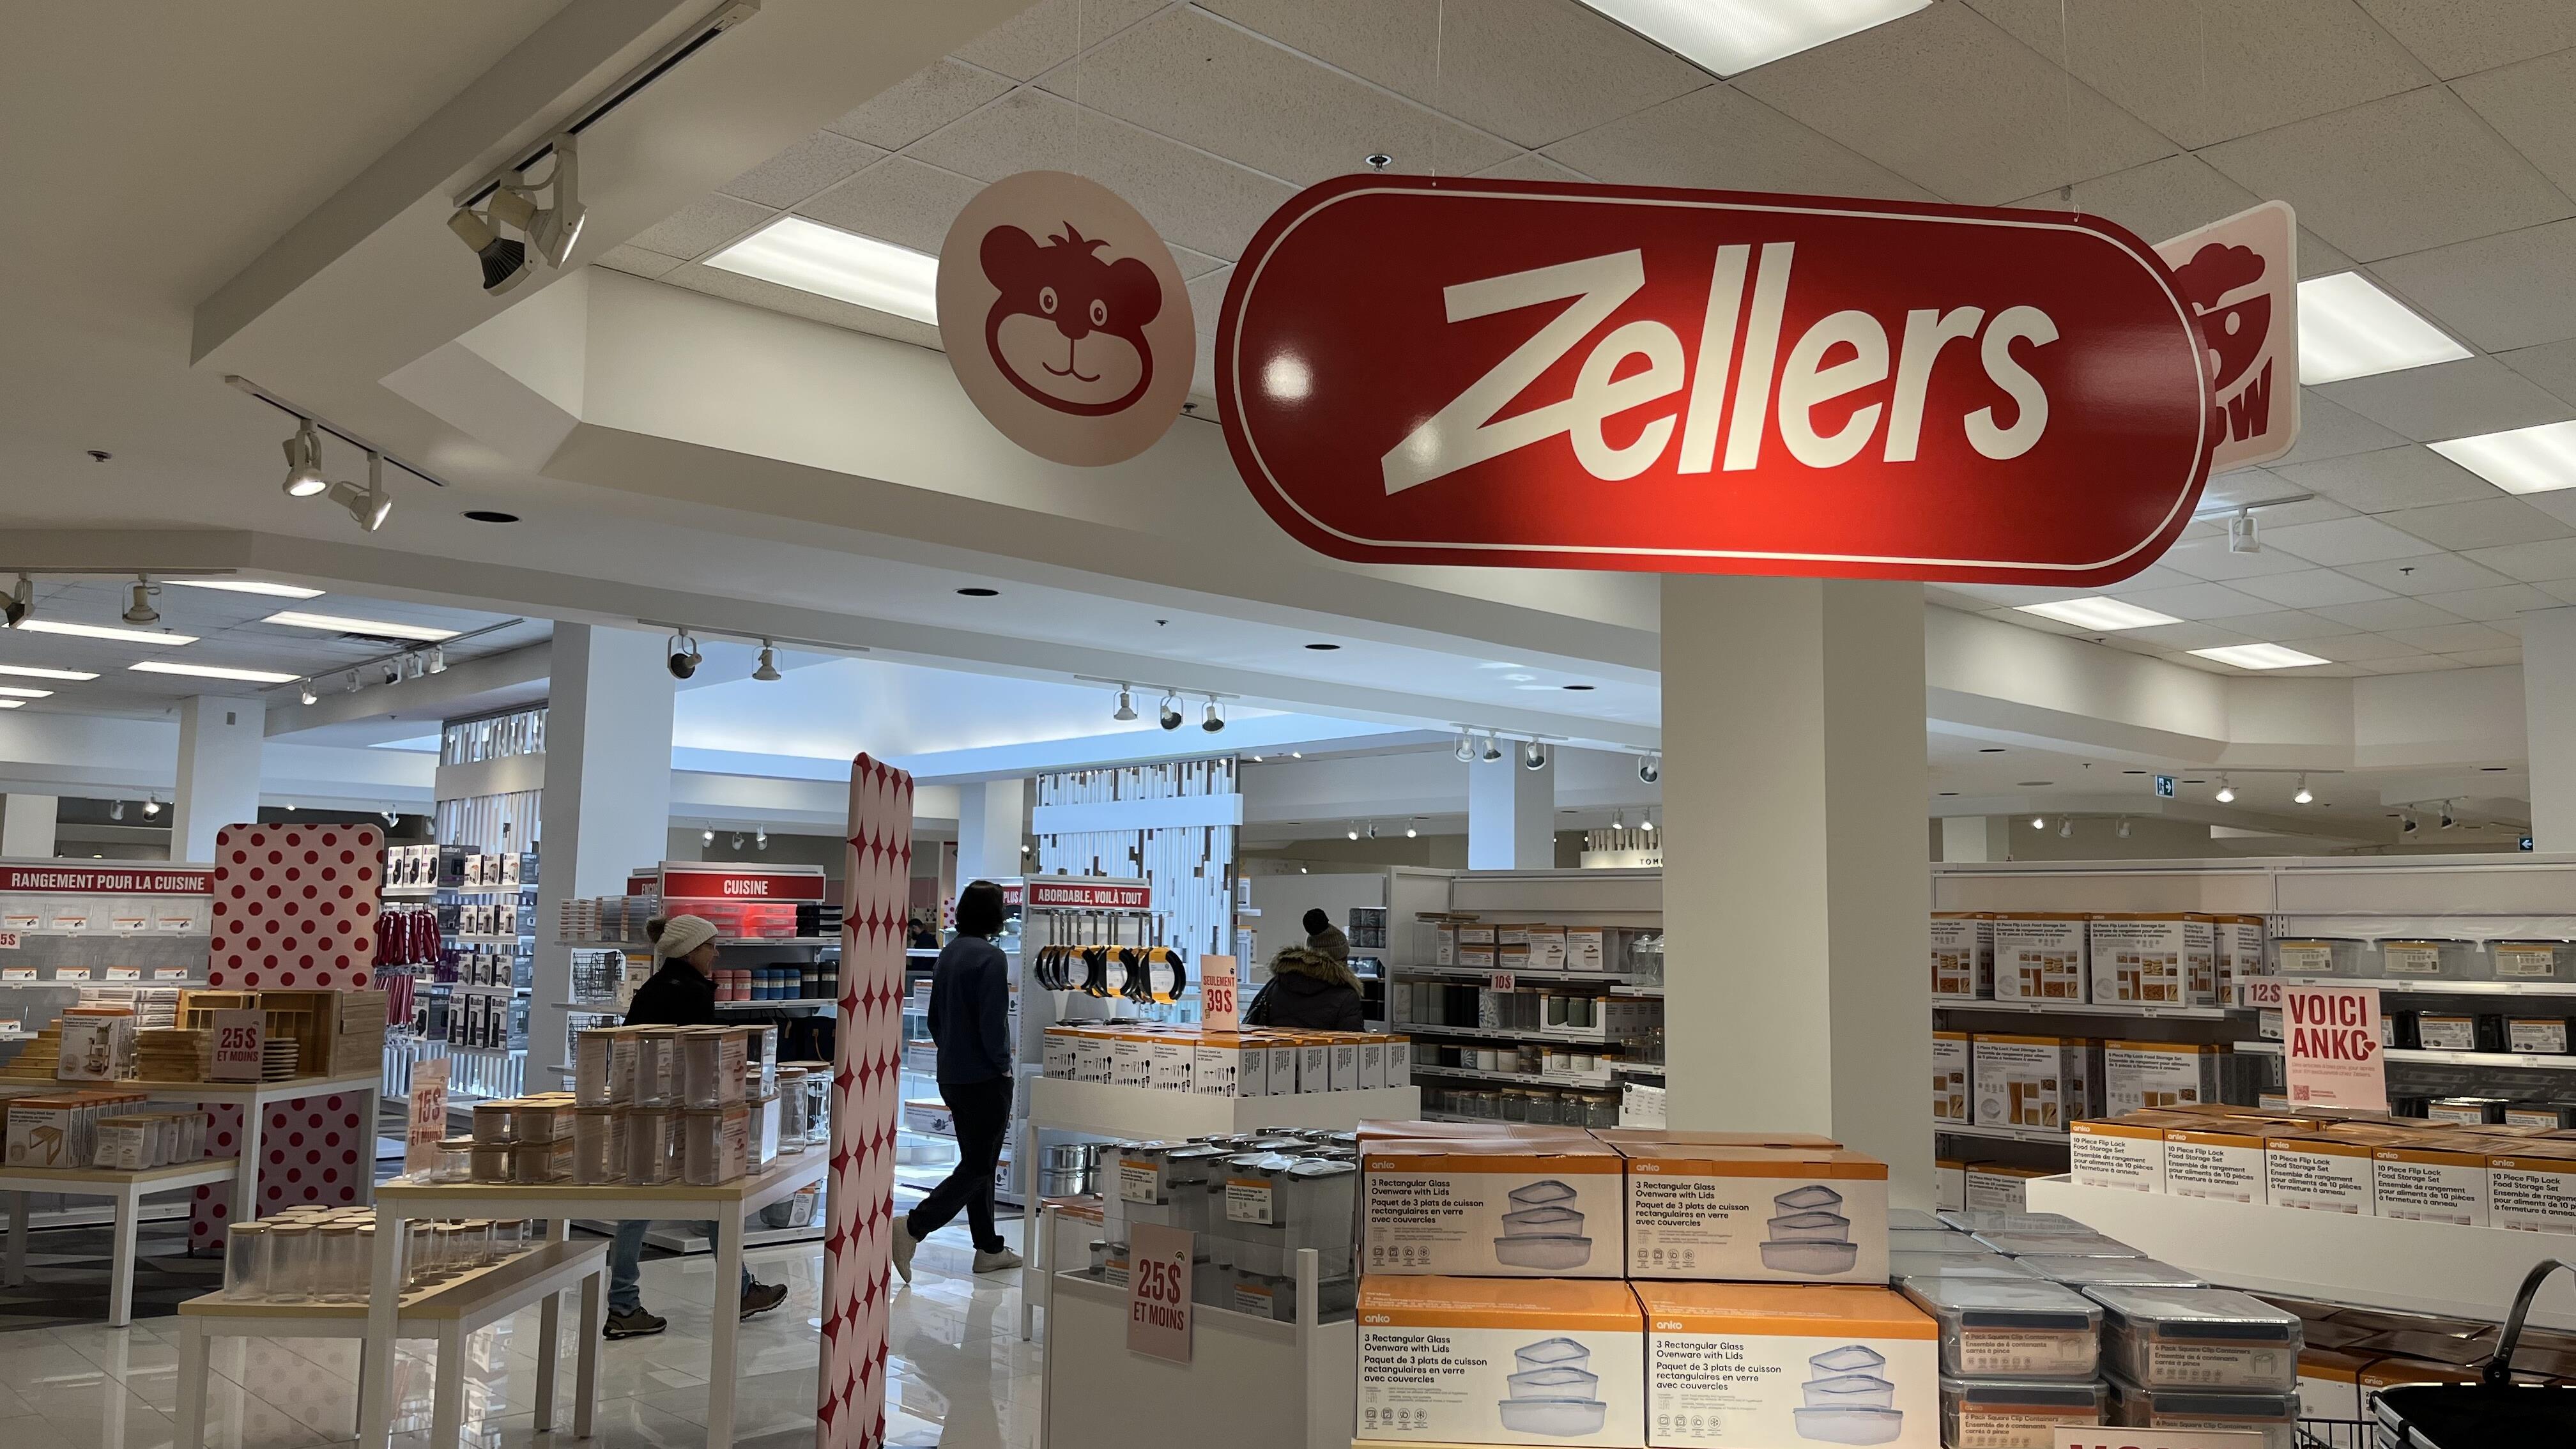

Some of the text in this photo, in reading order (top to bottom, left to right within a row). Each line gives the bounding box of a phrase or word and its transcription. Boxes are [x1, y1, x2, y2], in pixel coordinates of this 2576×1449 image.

[1381, 241, 2060, 496] Zellers
[12, 873, 204, 891] RANGEMENT POUR LA CUISINE
[724, 880, 769, 894] CUISINE
[1003, 891, 1018, 903] PLUS
[1038, 889, 1142, 905] ABORDABLE, VOILÀ TOUT
[1204, 976, 1234, 987] SEULEMENT
[1496, 975, 1511, 989] 10$
[2251, 983, 2280, 1003] 12$
[1207, 988, 1232, 1015] 39$
[2288, 994, 2367, 1027] VOICI
[221, 1027, 256, 1050] 25$
[2292, 1028, 2370, 1061] ANKO
[217, 1051, 259, 1062] ET MOINS
[418, 1086, 441, 1123] 15$
[411, 1130, 419, 1146] ET
[2099, 1139, 2109, 1147] Flip
[2089, 1145, 2112, 1153] Storage
[1372, 1161, 1395, 1169] anko
[1636, 1163, 1660, 1172] anko
[2288, 1163, 2315, 1171] Storage
[2271, 1170, 2303, 1178] Ensemble
[1379, 1179, 1427, 1188] Rectangular
[2277, 1184, 2311, 1193] fermeture
[2288, 1177, 2317, 1186] aliments
[2338, 1182, 2362, 1190] pièces
[1372, 1199, 1399, 1208] Paquet
[1421, 1199, 1439, 1208] plats
[1372, 1208, 1429, 1216] rectangulaires
[1137, 1258, 1182, 1307] 25$
[1133, 1301, 1184, 1331] ET MOINS
[1365, 1314, 1390, 1323] anko
[1657, 1319, 1682, 1330] anko
[1372, 1334, 1425, 1344] Rectangular
[1427, 1335, 1450, 1344] Glass
[1364, 1344, 1408, 1352] Ovenware
[1411, 1344, 1429, 1353] with
[1664, 1341, 1717, 1351] Rectangular
[1720, 1342, 1744, 1351] Glass
[1657, 1350, 1743, 1360] Ovenware with Lids
[1364, 1355, 1394, 1365] Paquet
[1418, 1357, 1439, 1367] plats
[1454, 1358, 1487, 1366] cuisson
[1364, 1365, 1427, 1374] rectangulaires
[1657, 1362, 1687, 1372] Paquet
[1711, 1364, 1732, 1374] plats
[1657, 1372, 1720, 1382] rectangulaires
[2365, 1377, 2383, 1385] anko
[1680, 1382, 1728, 1390] couvercles
